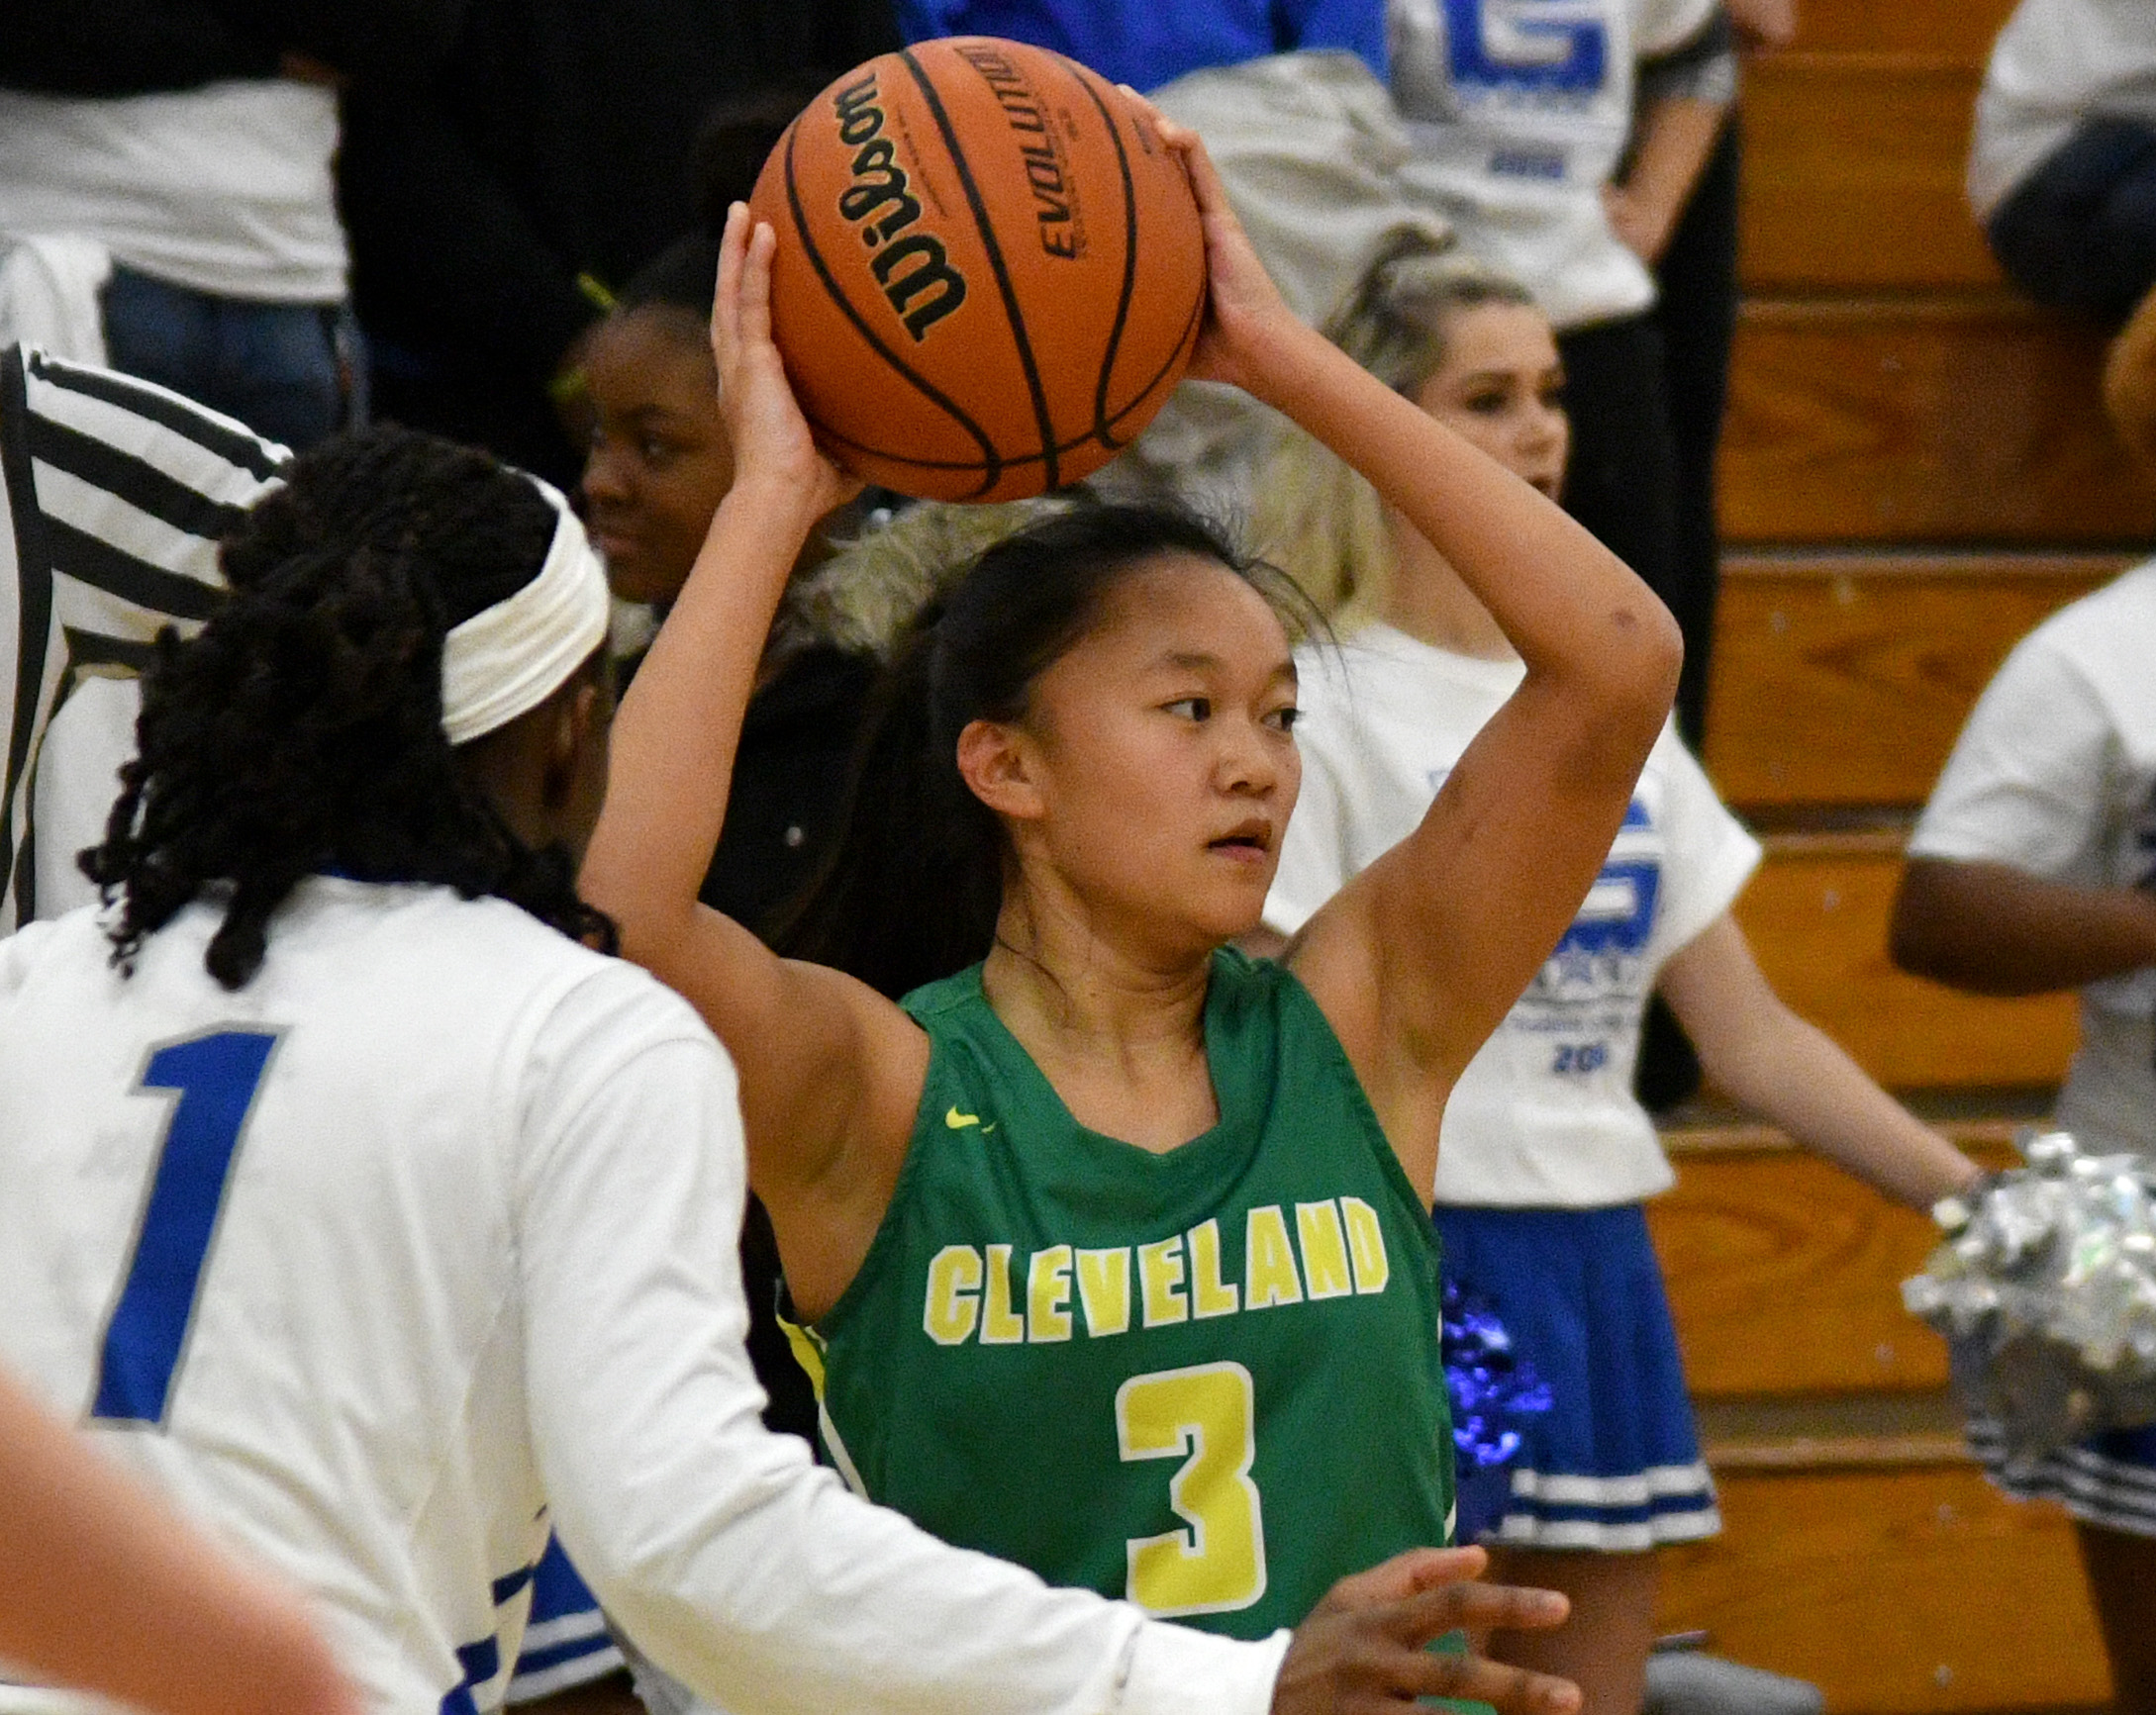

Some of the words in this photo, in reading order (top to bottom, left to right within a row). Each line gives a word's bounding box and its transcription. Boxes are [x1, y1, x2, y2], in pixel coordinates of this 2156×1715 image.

[832, 71, 968, 343] Wilson
[82, 1021, 293, 1435] 1
[924, 1196, 1389, 1346] CLEVELAND
[1116, 1361, 1267, 1618] 3
